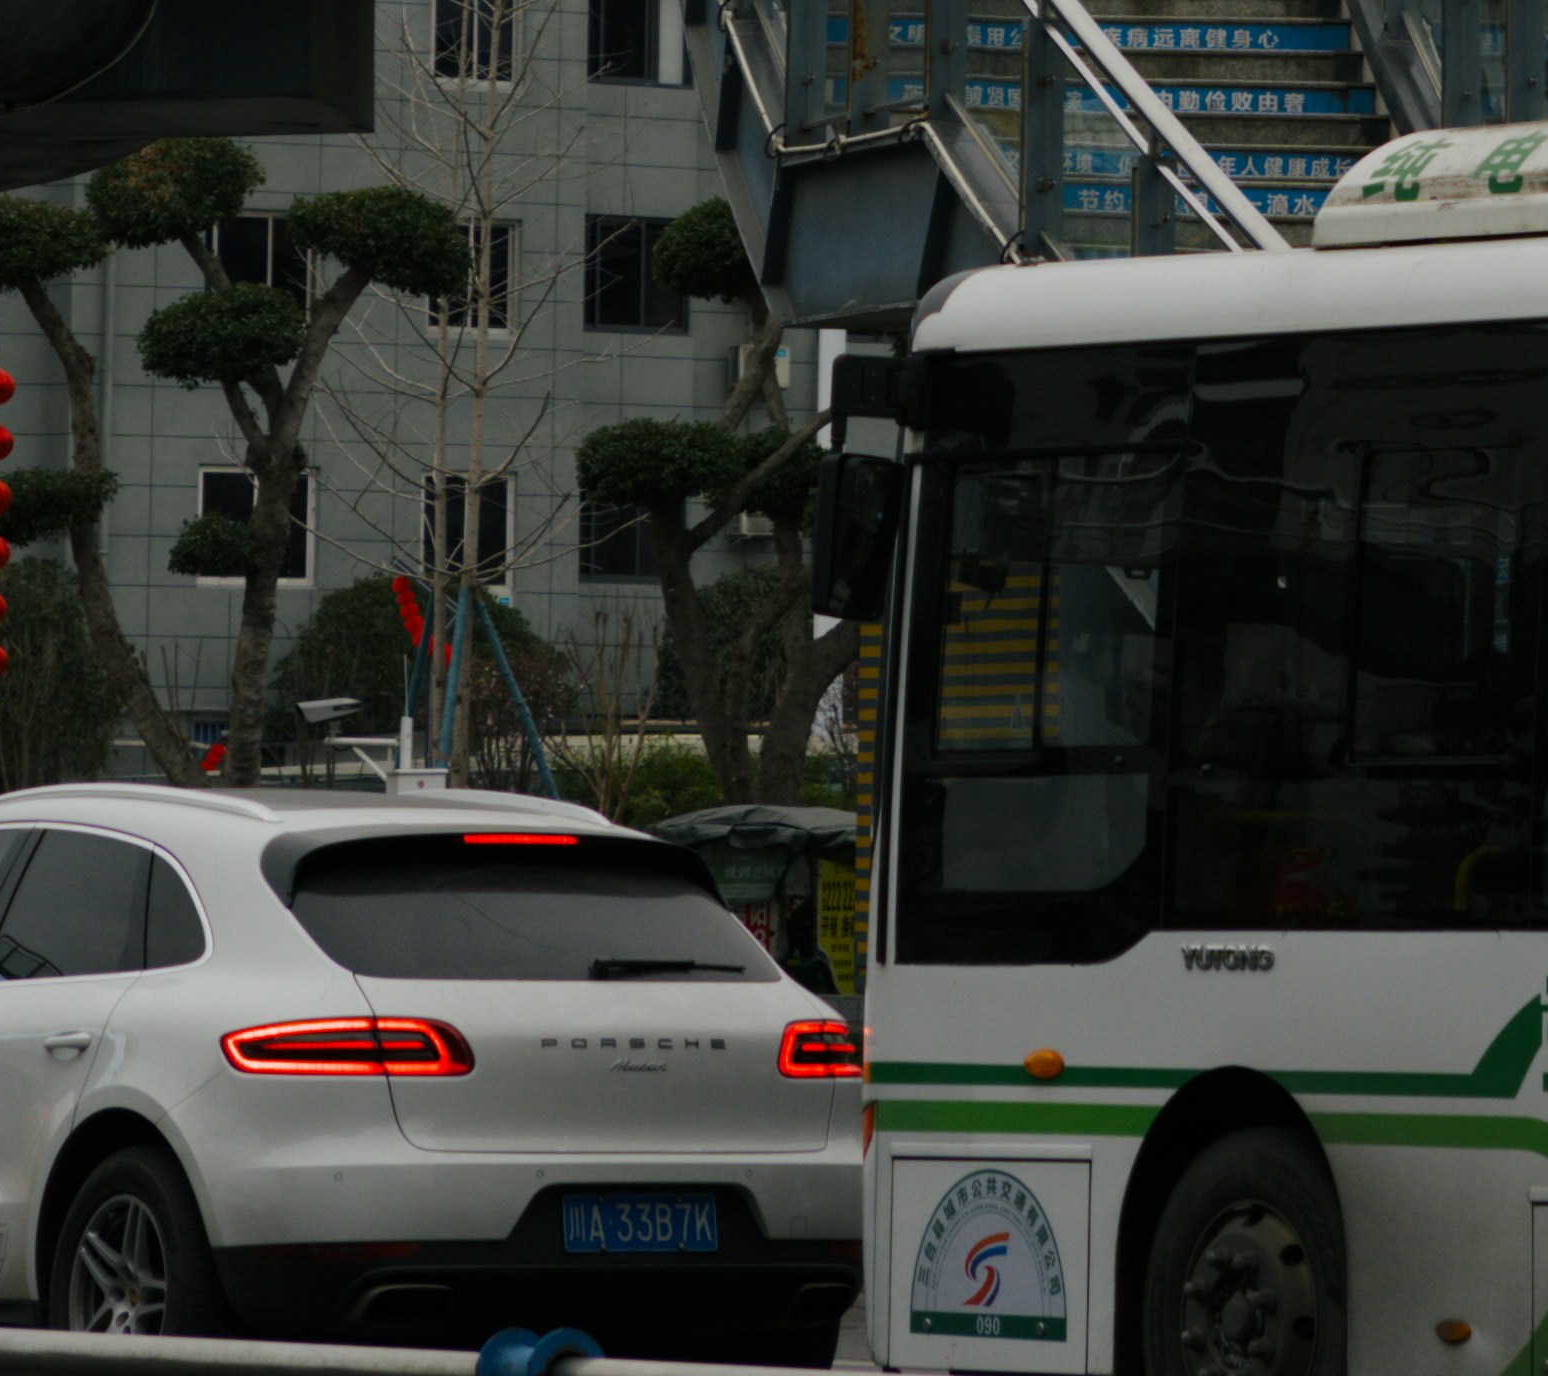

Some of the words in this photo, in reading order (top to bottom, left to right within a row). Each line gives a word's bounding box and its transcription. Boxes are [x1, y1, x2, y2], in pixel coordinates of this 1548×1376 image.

[1155, 90, 1305, 113] 由勤俭败由奢
[1181, 946, 1275, 972] YUTONG
[541, 1038, 727, 1050] PORSCHE
[976, 1315, 1001, 1336] 090
